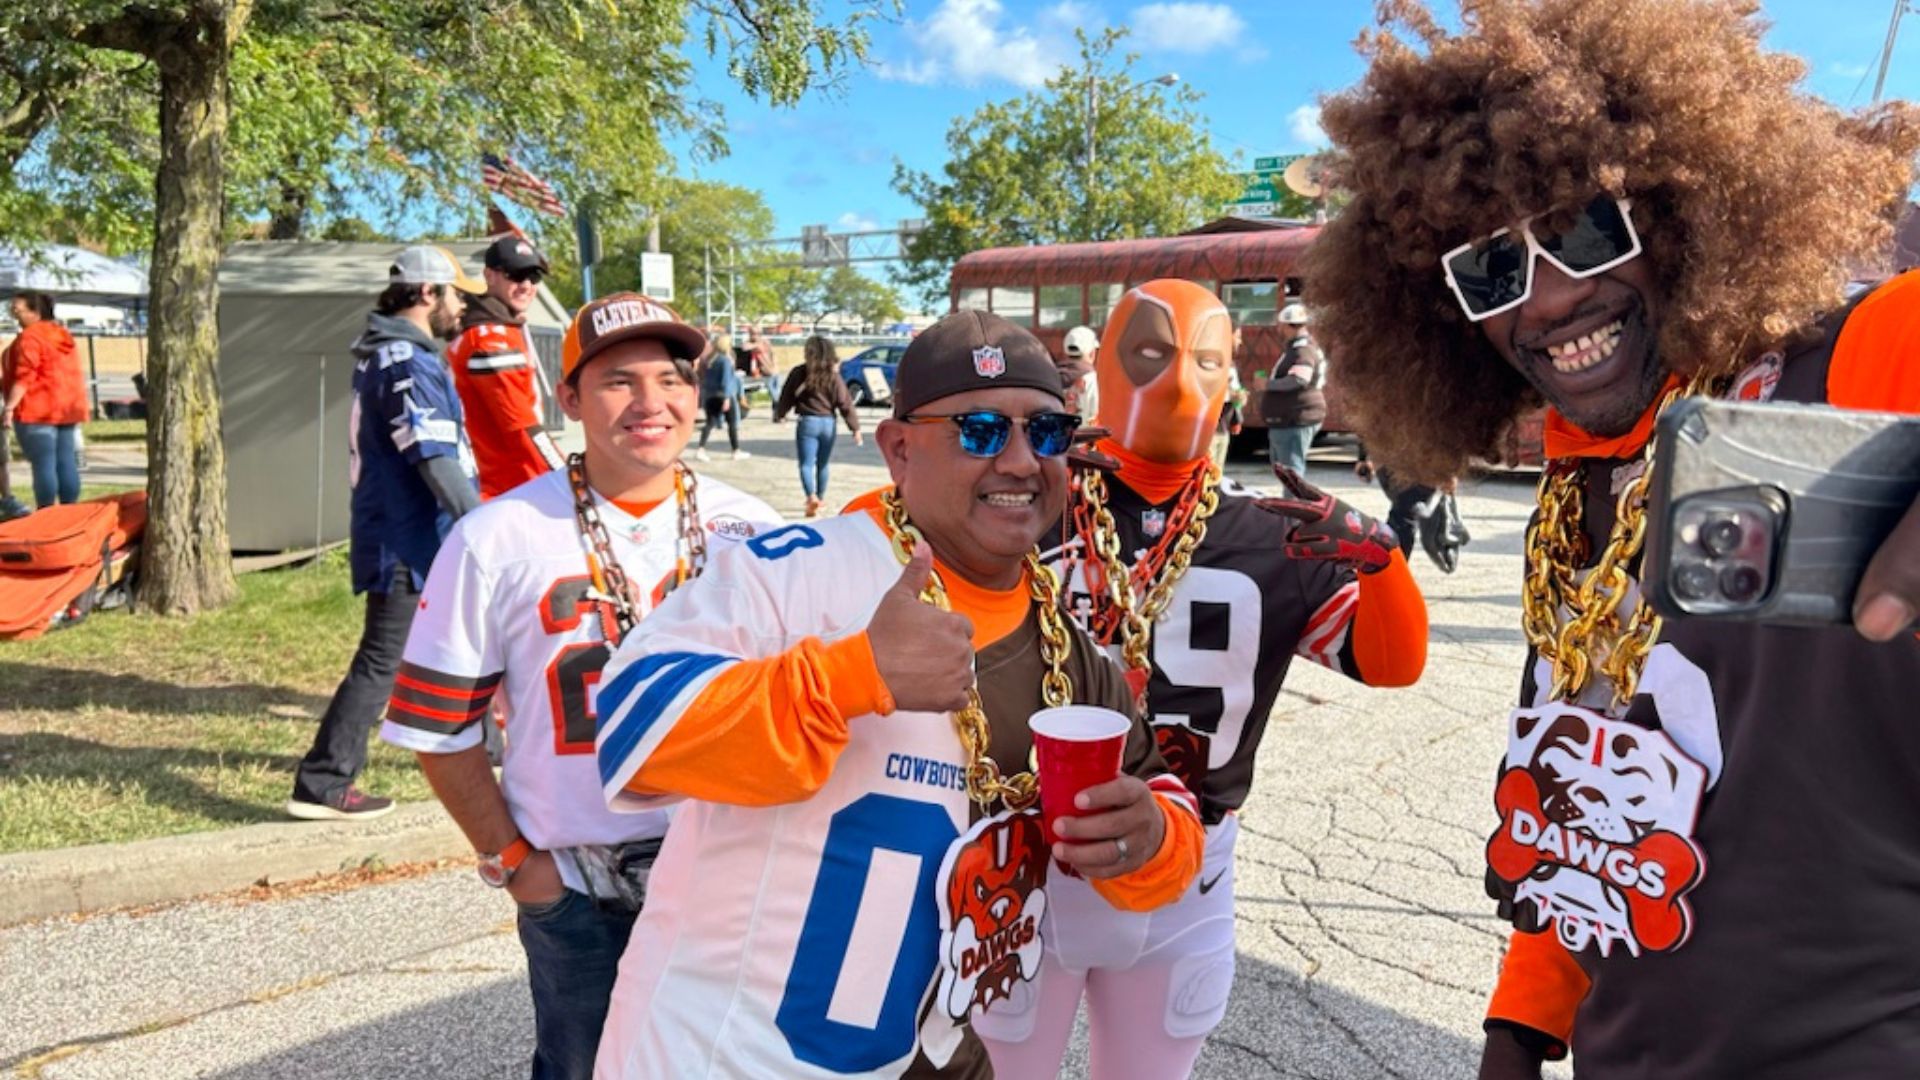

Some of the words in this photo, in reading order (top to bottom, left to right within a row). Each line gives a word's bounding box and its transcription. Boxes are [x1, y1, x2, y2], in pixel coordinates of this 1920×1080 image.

[885, 752, 968, 791] COWBOYS
[1510, 808, 1666, 899] DAWGS
[775, 792, 961, 1074] 0
[961, 914, 1035, 979] DAWGS
